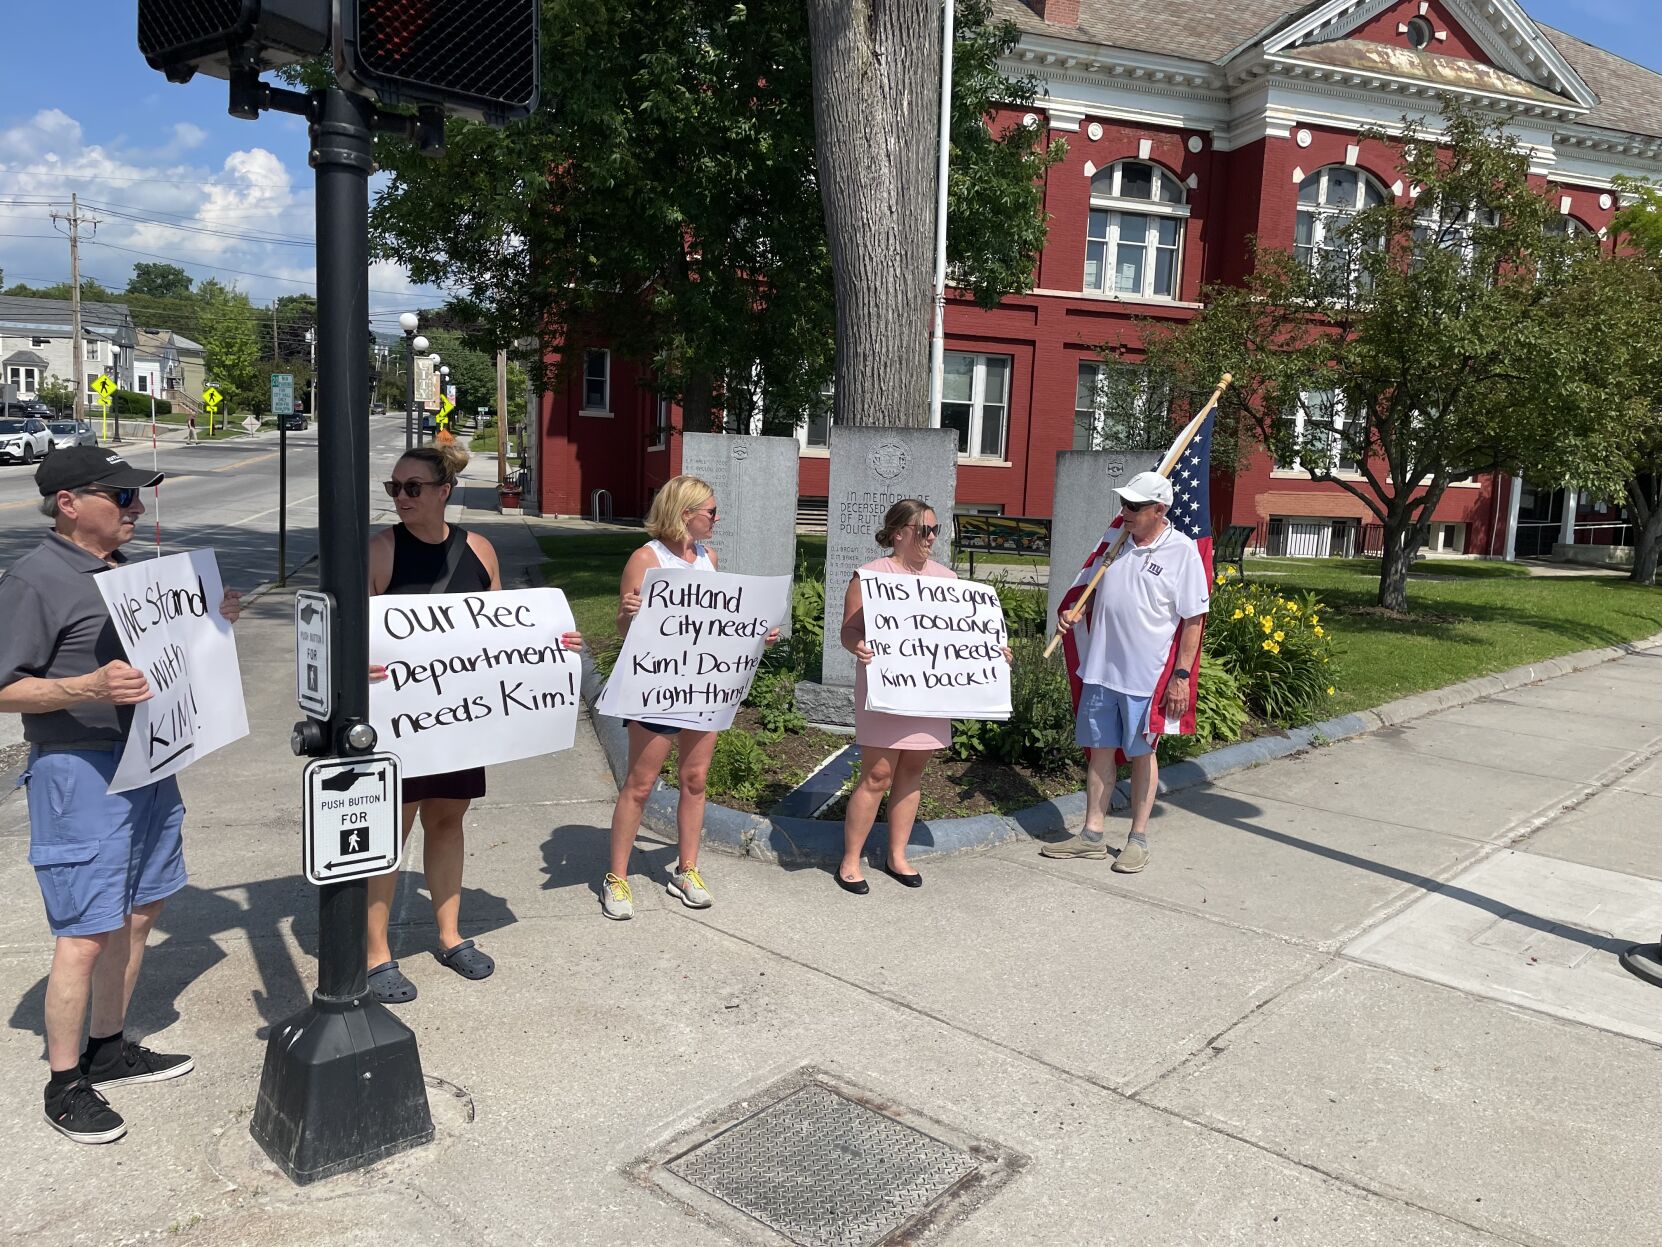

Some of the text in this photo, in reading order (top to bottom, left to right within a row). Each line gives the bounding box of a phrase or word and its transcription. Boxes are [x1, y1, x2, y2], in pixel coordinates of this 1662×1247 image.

[841, 502, 885, 513] DECEASED
[846, 491, 856, 502] IN
[840, 513, 853, 524] OF
[840, 524, 871, 534] POLICE
[113, 575, 209, 648] We Stand
[463, 596, 536, 629] Rec
[647, 579, 743, 614] Rutland
[860, 576, 1001, 619] This has gone
[660, 614, 769, 646] City needs
[306, 647, 318, 661] FOR
[384, 637, 568, 696] Department
[633, 650, 759, 677] Kim! Do the
[866, 637, 1002, 670] The City needs
[880, 666, 998, 689] Kim back!!
[499, 671, 575, 717] Kim!
[641, 679, 750, 712] right thing!
[150, 683, 202, 758] KIM!
[390, 695, 493, 739] needs
[321, 794, 381, 811] PUSH BUTTON
[341, 811, 368, 826] FOR
